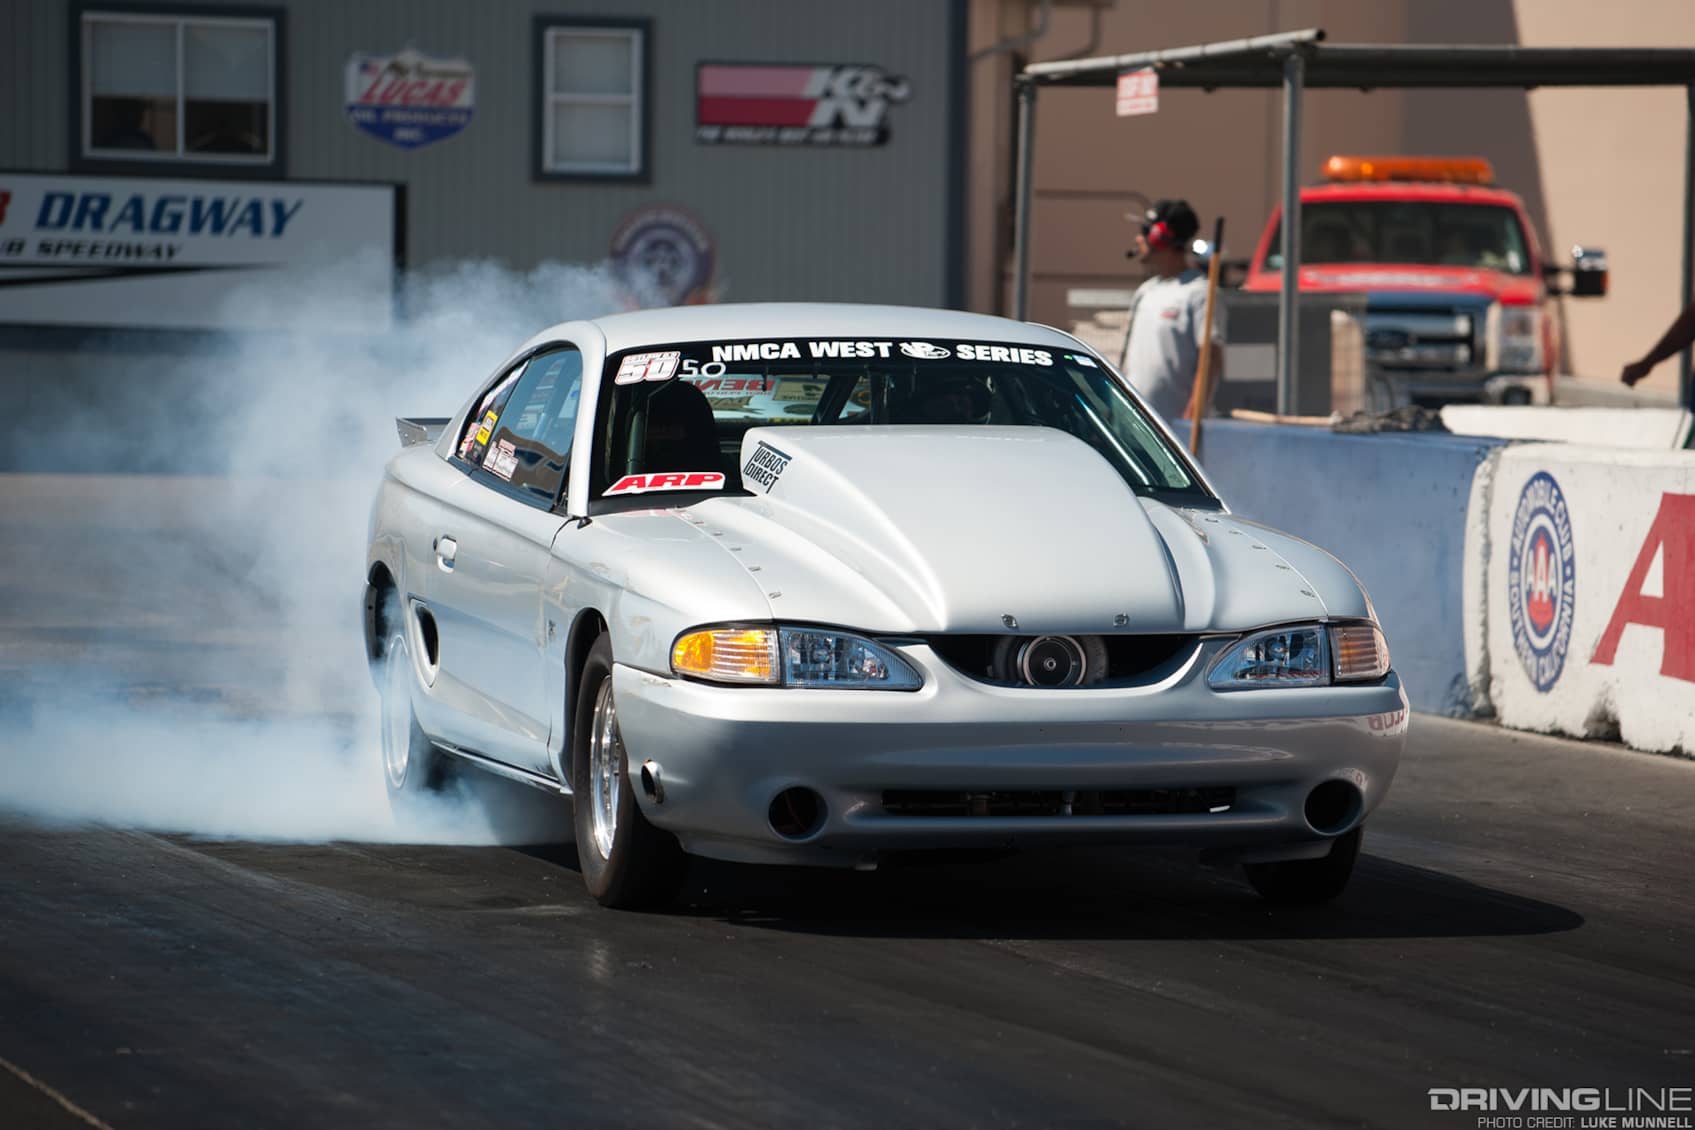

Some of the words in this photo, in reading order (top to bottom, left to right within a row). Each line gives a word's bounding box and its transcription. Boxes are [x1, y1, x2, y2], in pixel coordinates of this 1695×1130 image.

[358, 76, 468, 107] LUCAS
[35, 191, 302, 238] DRAGWAY
[36, 239, 181, 262] SPEEDWAY
[712, 342, 801, 362] NMCA
[809, 341, 893, 358] WEST
[956, 344, 1054, 367] SERIES
[743, 440, 793, 475] TURBOS
[610, 473, 724, 491] ARP
[745, 462, 779, 494] DIRECT
